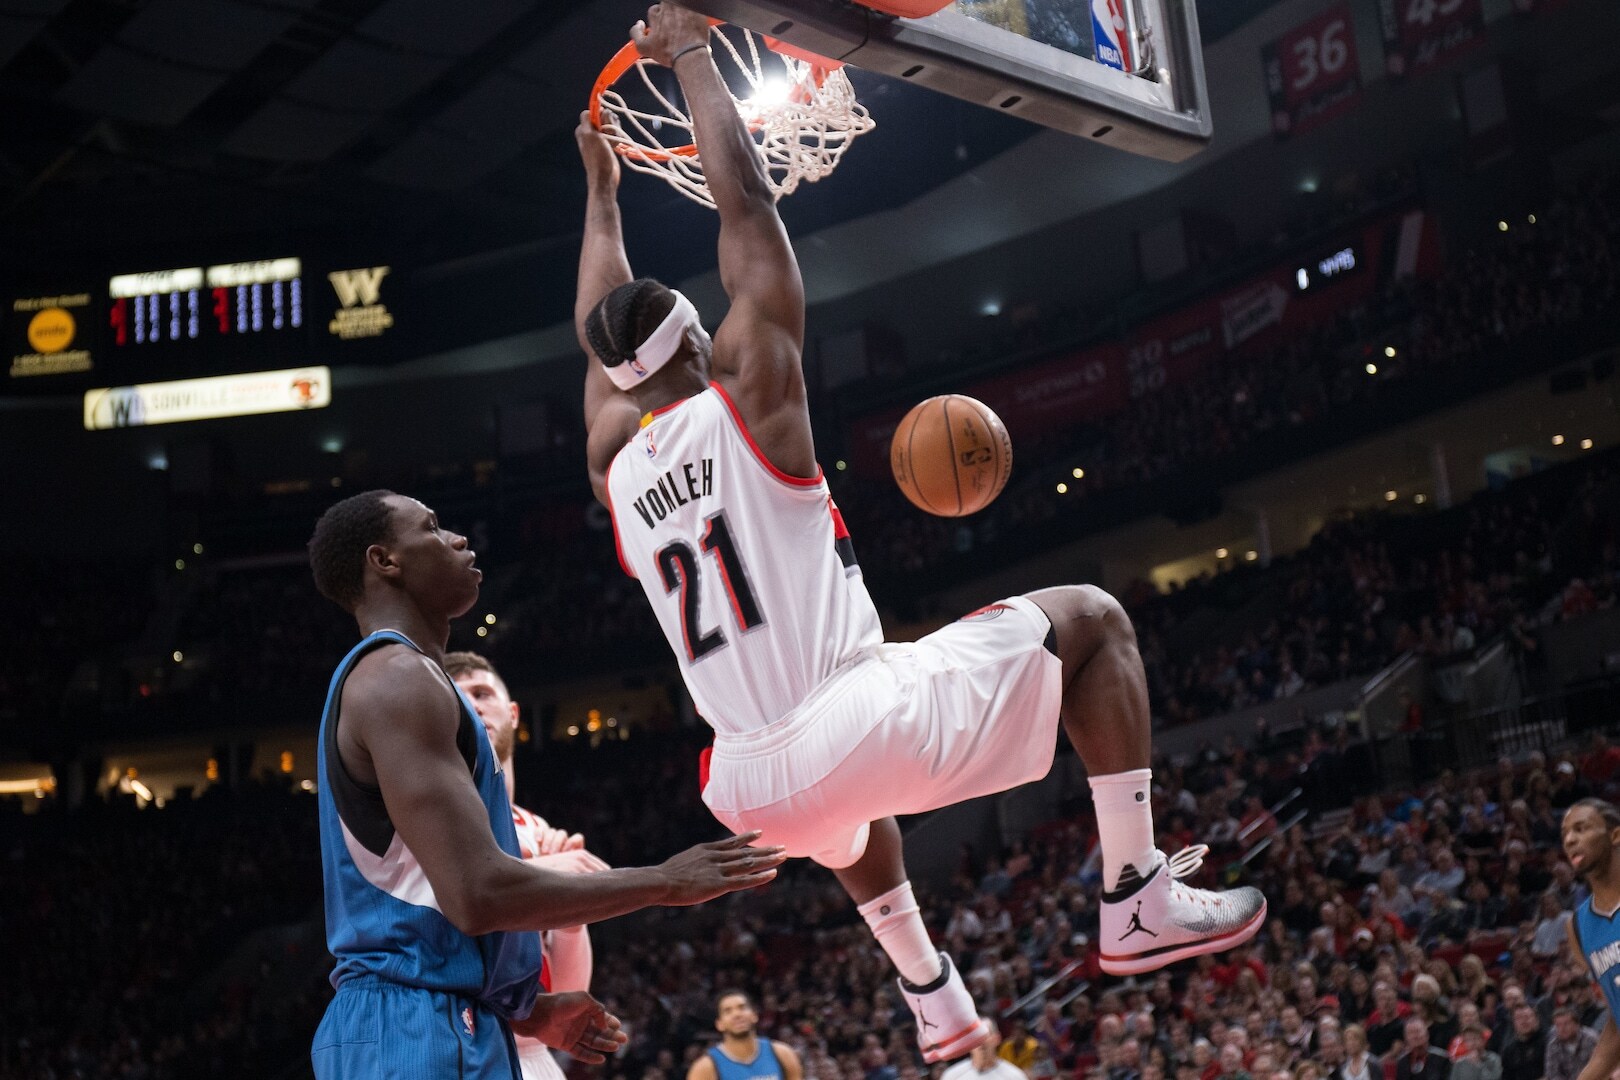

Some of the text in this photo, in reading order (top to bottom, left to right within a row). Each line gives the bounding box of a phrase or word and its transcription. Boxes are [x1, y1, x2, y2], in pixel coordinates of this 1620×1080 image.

[1098, 44, 1121, 65] NBA
[1291, 19, 1348, 91] 36
[633, 458, 713, 531] VONLEH
[654, 508, 768, 667] 21
